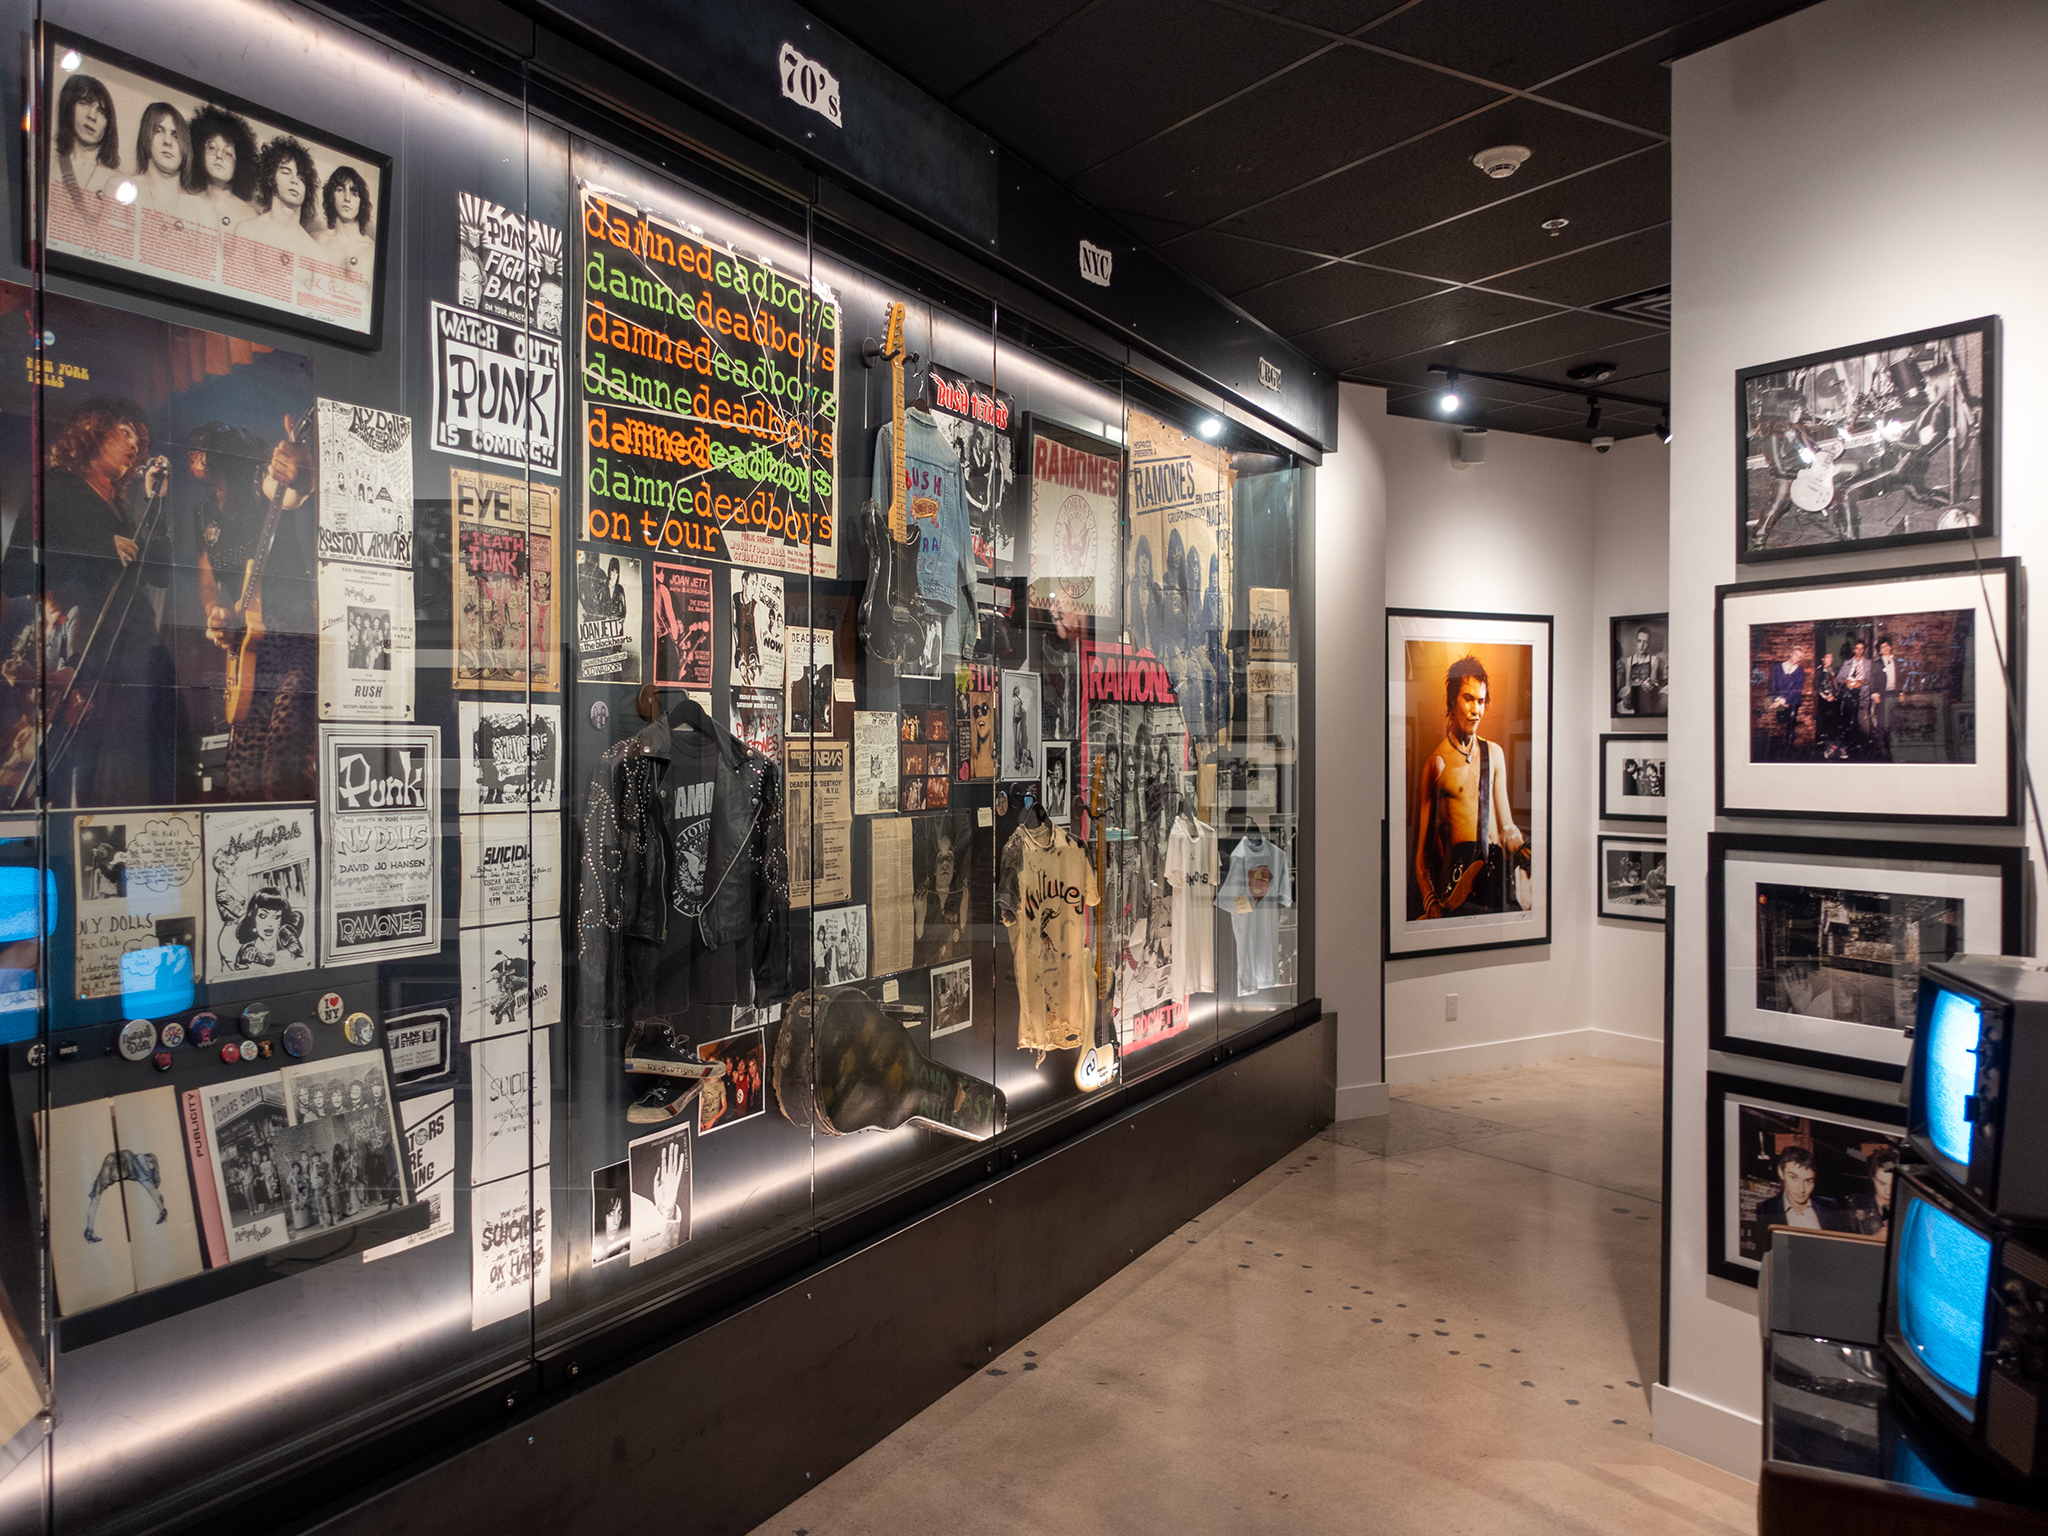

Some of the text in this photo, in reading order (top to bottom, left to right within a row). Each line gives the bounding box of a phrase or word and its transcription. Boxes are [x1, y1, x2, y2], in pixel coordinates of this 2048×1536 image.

[784, 52, 838, 117] 70's
[486, 215, 541, 266] PUNK
[484, 250, 541, 288] FIGHTS
[1082, 246, 1109, 281] NYC
[483, 275, 538, 311] BACK
[439, 310, 560, 369] WATCH OUT!
[58, 363, 90, 380] YORK
[449, 354, 554, 440] PUNK
[929, 372, 1009, 431] BUSH TETRAS
[348, 406, 375, 433] NY
[439, 421, 555, 467] IS COMING!!
[1034, 437, 1119, 499] RAMONES
[458, 476, 510, 493] EAST VILLAGE
[1134, 460, 1195, 509] RAMONES
[458, 485, 510, 522] EYE
[1167, 511, 1184, 524] GRUPO
[319, 527, 412, 562] BOSTON ARMORY
[473, 531, 525, 552] DEATH
[589, 508, 721, 553] on tour
[741, 532, 775, 545] PUBLIC CONCERT
[469, 545, 518, 578] PUNK
[670, 575, 708, 589] JOAN JETT
[580, 620, 624, 641] JOAN JETT
[763, 637, 784, 653] NOW
[354, 685, 383, 698] RUSH
[1088, 655, 1174, 704] RAMONE
[492, 733, 548, 764] SUICDE
[815, 751, 842, 768] NEWS
[338, 751, 425, 808] Punk
[675, 782, 715, 819] AMO
[374, 824, 428, 853] DOLLS
[339, 863, 369, 874] DAVID
[374, 862, 387, 871] JO
[390, 859, 426, 869] HANSEN
[484, 844, 530, 866] SUICID
[77, 912, 153, 936] N.Y. DOLLS
[338, 910, 424, 943] RAMONES
[80, 936, 120, 950] Fan Club
[324, 998, 330, 1010] I
[516, 984, 549, 1008] UNANOS
[324, 1008, 340, 1021] NY
[401, 1030, 421, 1040] PUNK
[647, 1064, 694, 1075] REVOLUTION
[188, 1093, 204, 1158] PUBLICITY
[489, 1263, 505, 1284] OK
